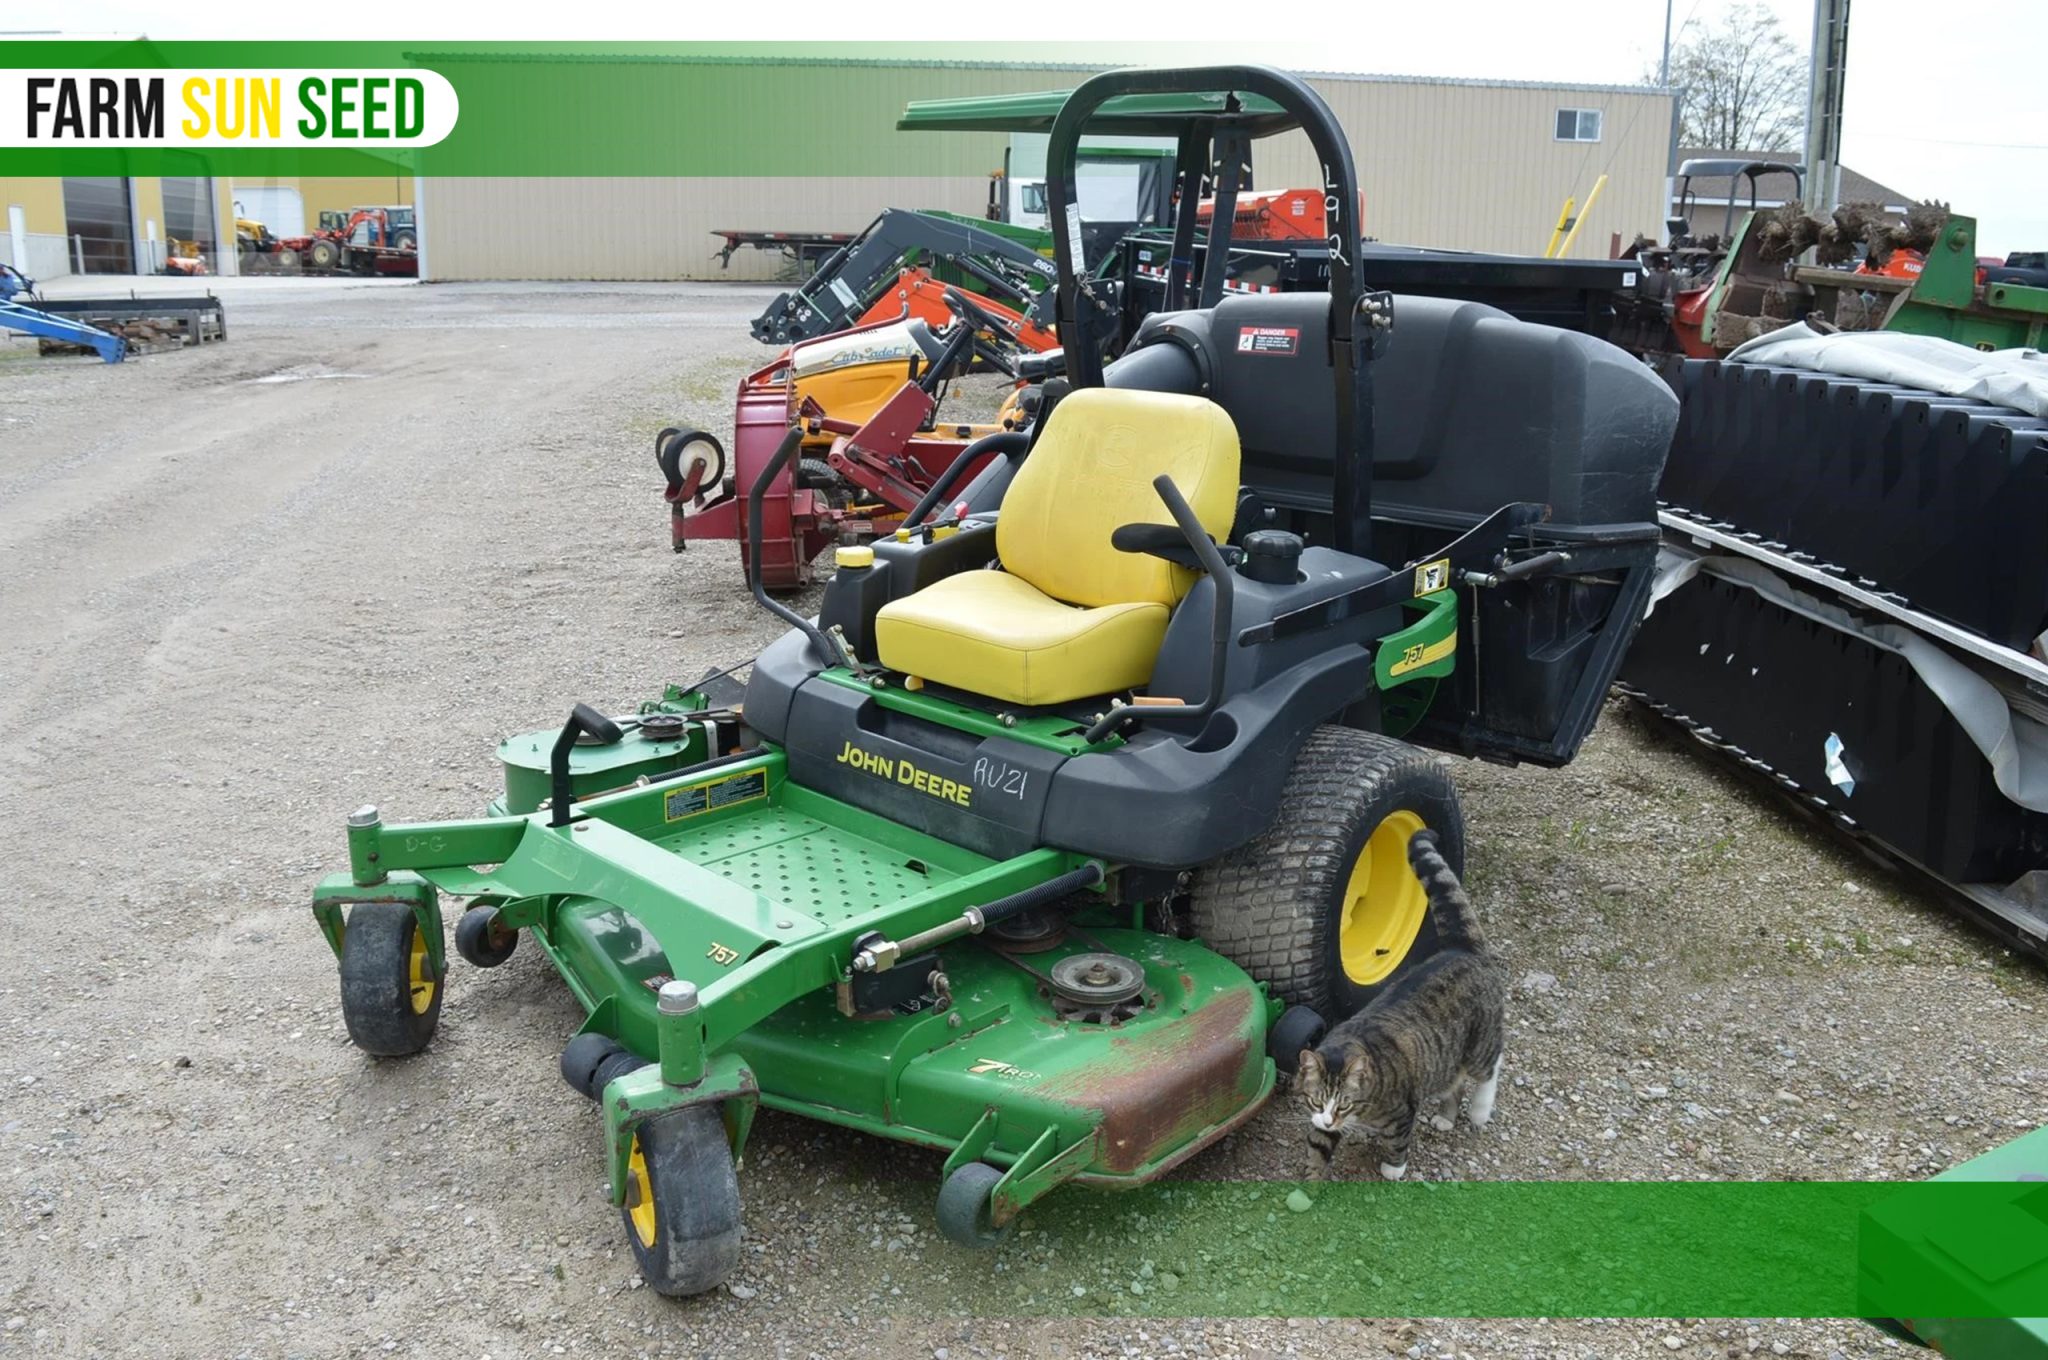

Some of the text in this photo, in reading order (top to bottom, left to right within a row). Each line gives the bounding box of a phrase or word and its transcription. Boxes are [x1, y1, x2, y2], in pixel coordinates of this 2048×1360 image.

[1032, 257, 1056, 276] 260
[1403, 642, 1425, 665] 757
[836, 741, 972, 807] JOHN DEERE
[705, 942, 740, 967] 757
